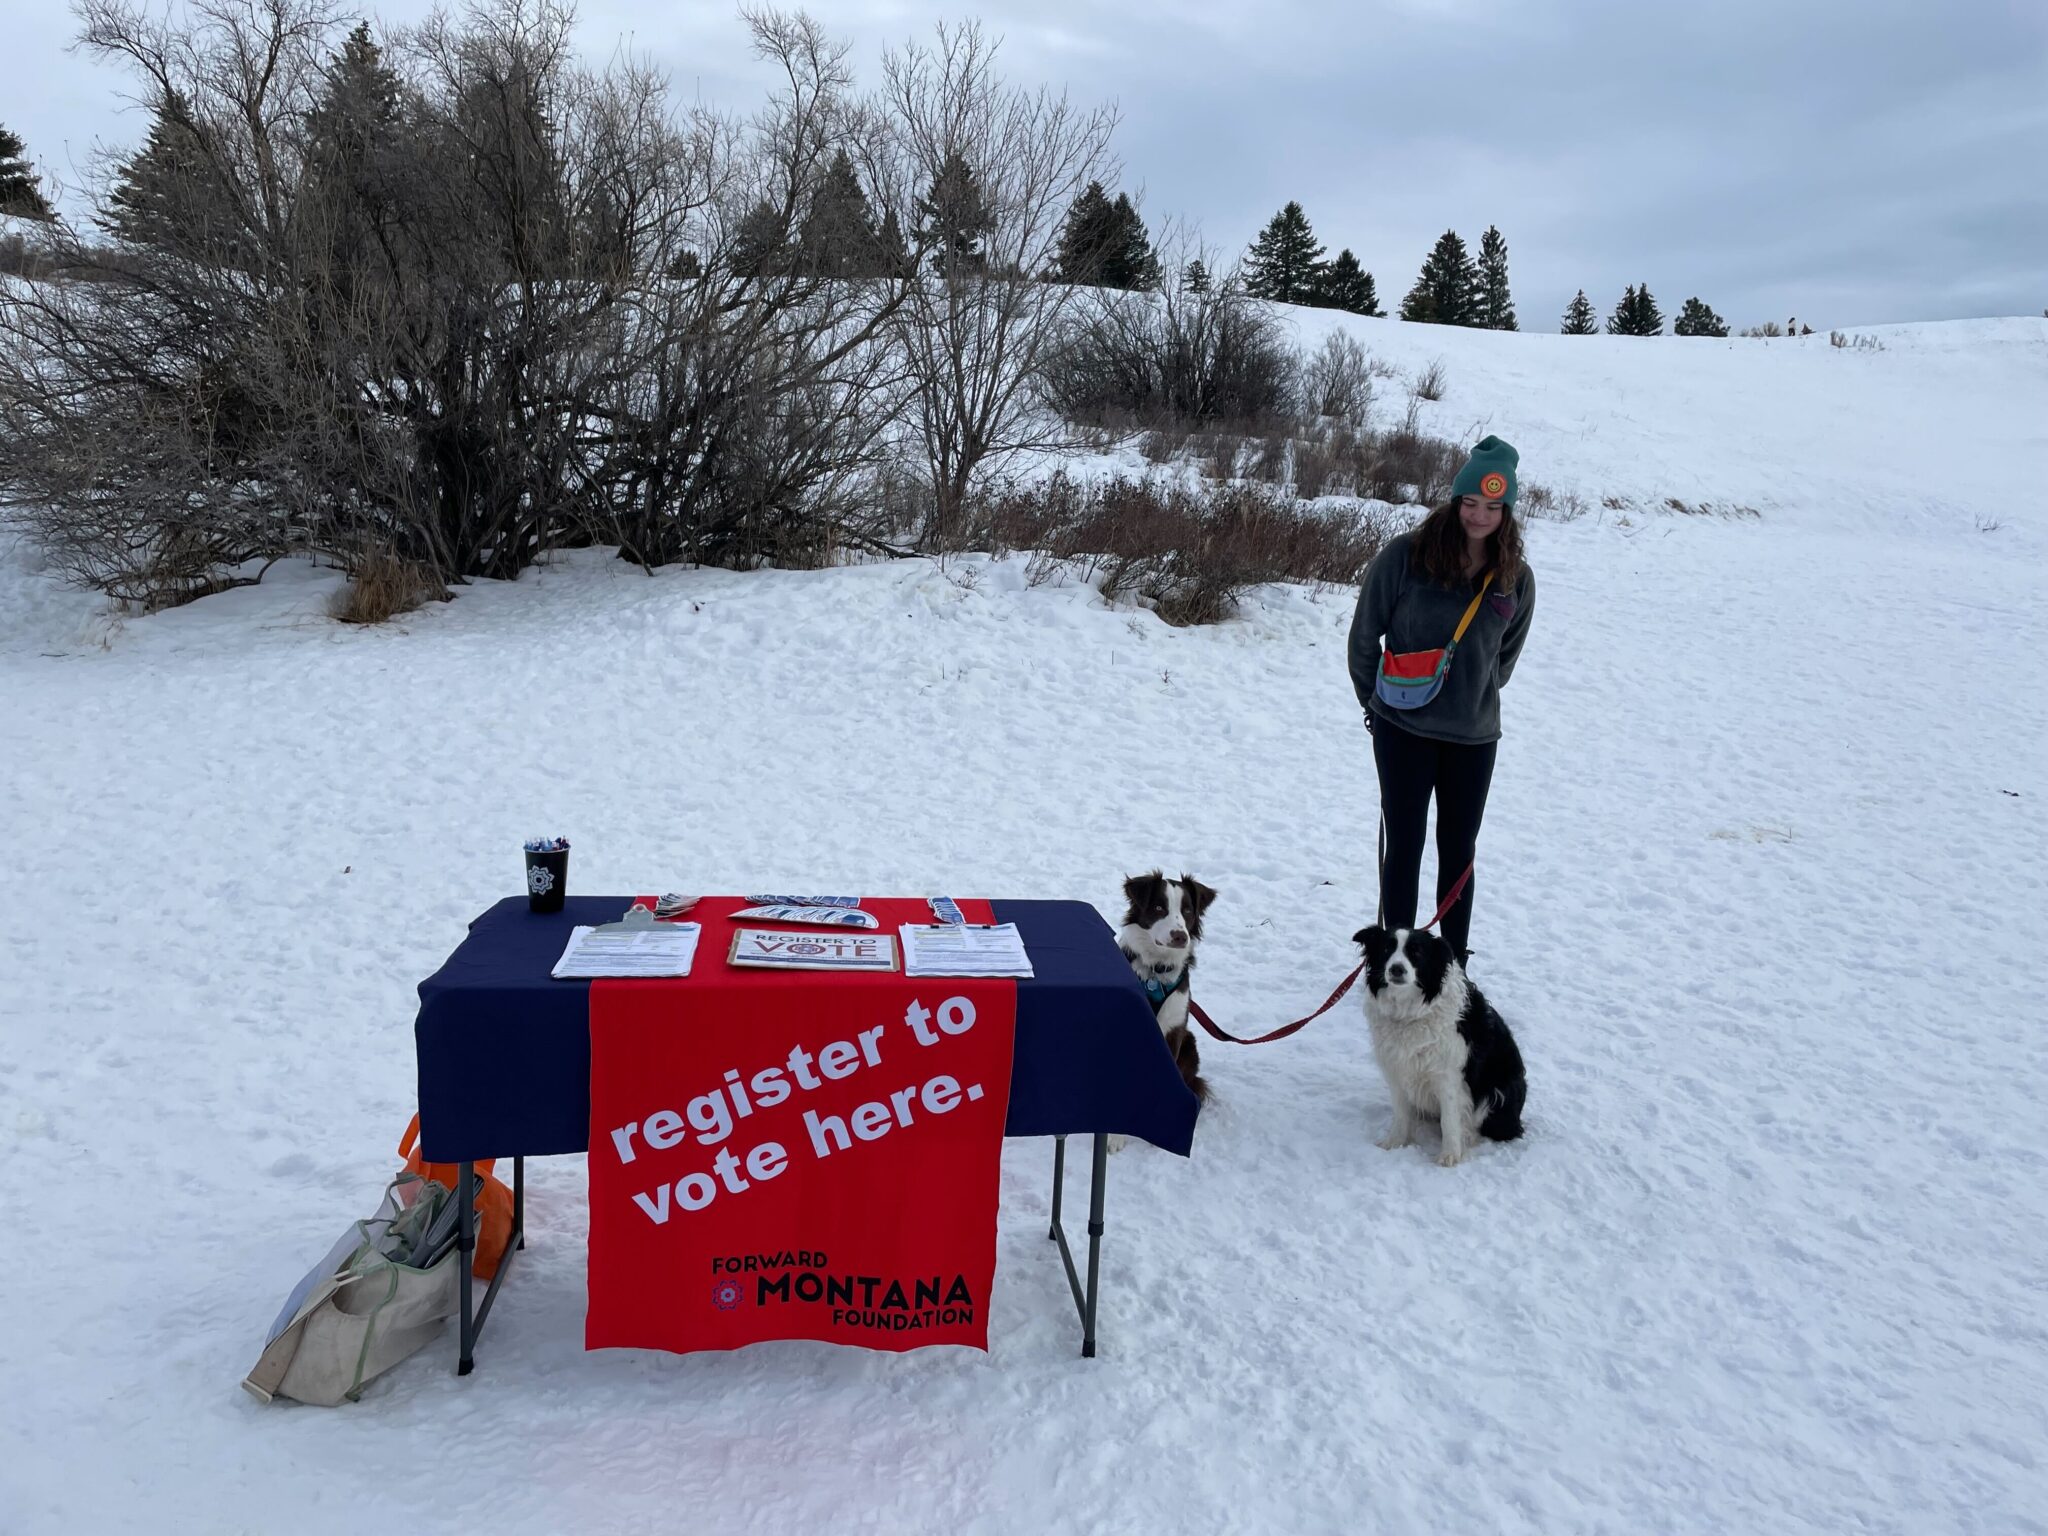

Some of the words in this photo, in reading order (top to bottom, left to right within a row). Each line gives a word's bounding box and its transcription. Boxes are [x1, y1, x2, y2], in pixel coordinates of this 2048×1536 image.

[755, 940, 877, 957] VOTE
[756, 934, 844, 945] REGISTER
[610, 1025, 884, 1165] register
[904, 996, 977, 1047] to
[631, 1141, 789, 1225] vote
[803, 1075, 984, 1159] here.
[712, 1250, 828, 1275] FORWARD
[757, 1272, 974, 1311] MONTANA
[832, 1308, 974, 1331] FOUNDATION
